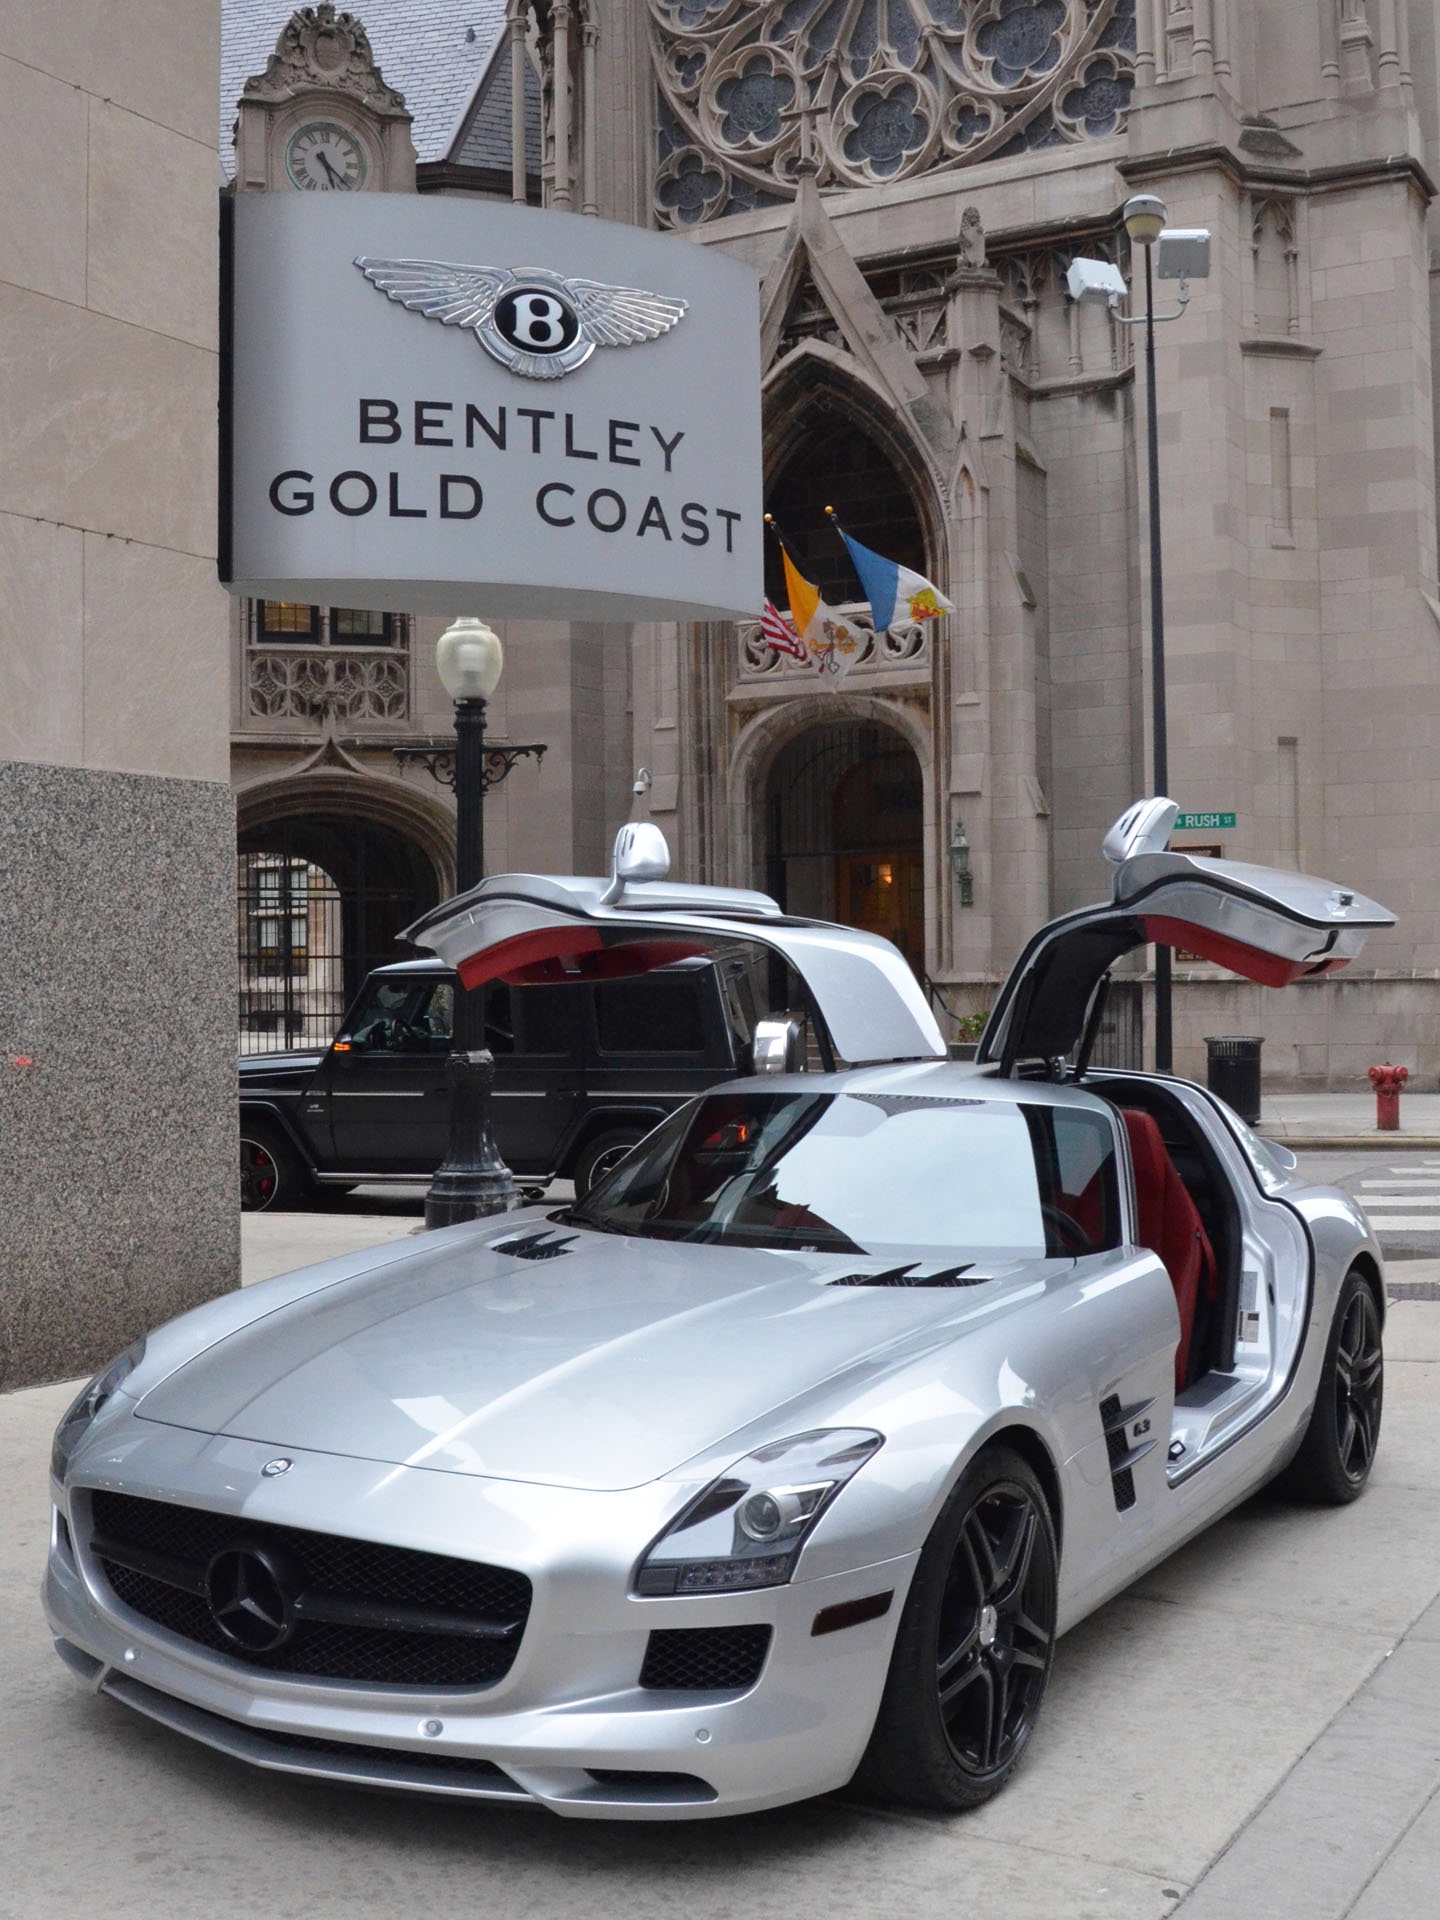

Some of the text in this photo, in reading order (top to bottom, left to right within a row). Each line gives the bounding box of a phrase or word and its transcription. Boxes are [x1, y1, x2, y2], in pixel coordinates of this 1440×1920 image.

[512, 293, 565, 348] B
[359, 398, 686, 472] BENTLEY
[269, 470, 742, 553] GOLD COAST
[1185, 815, 1220, 827] RUSH
